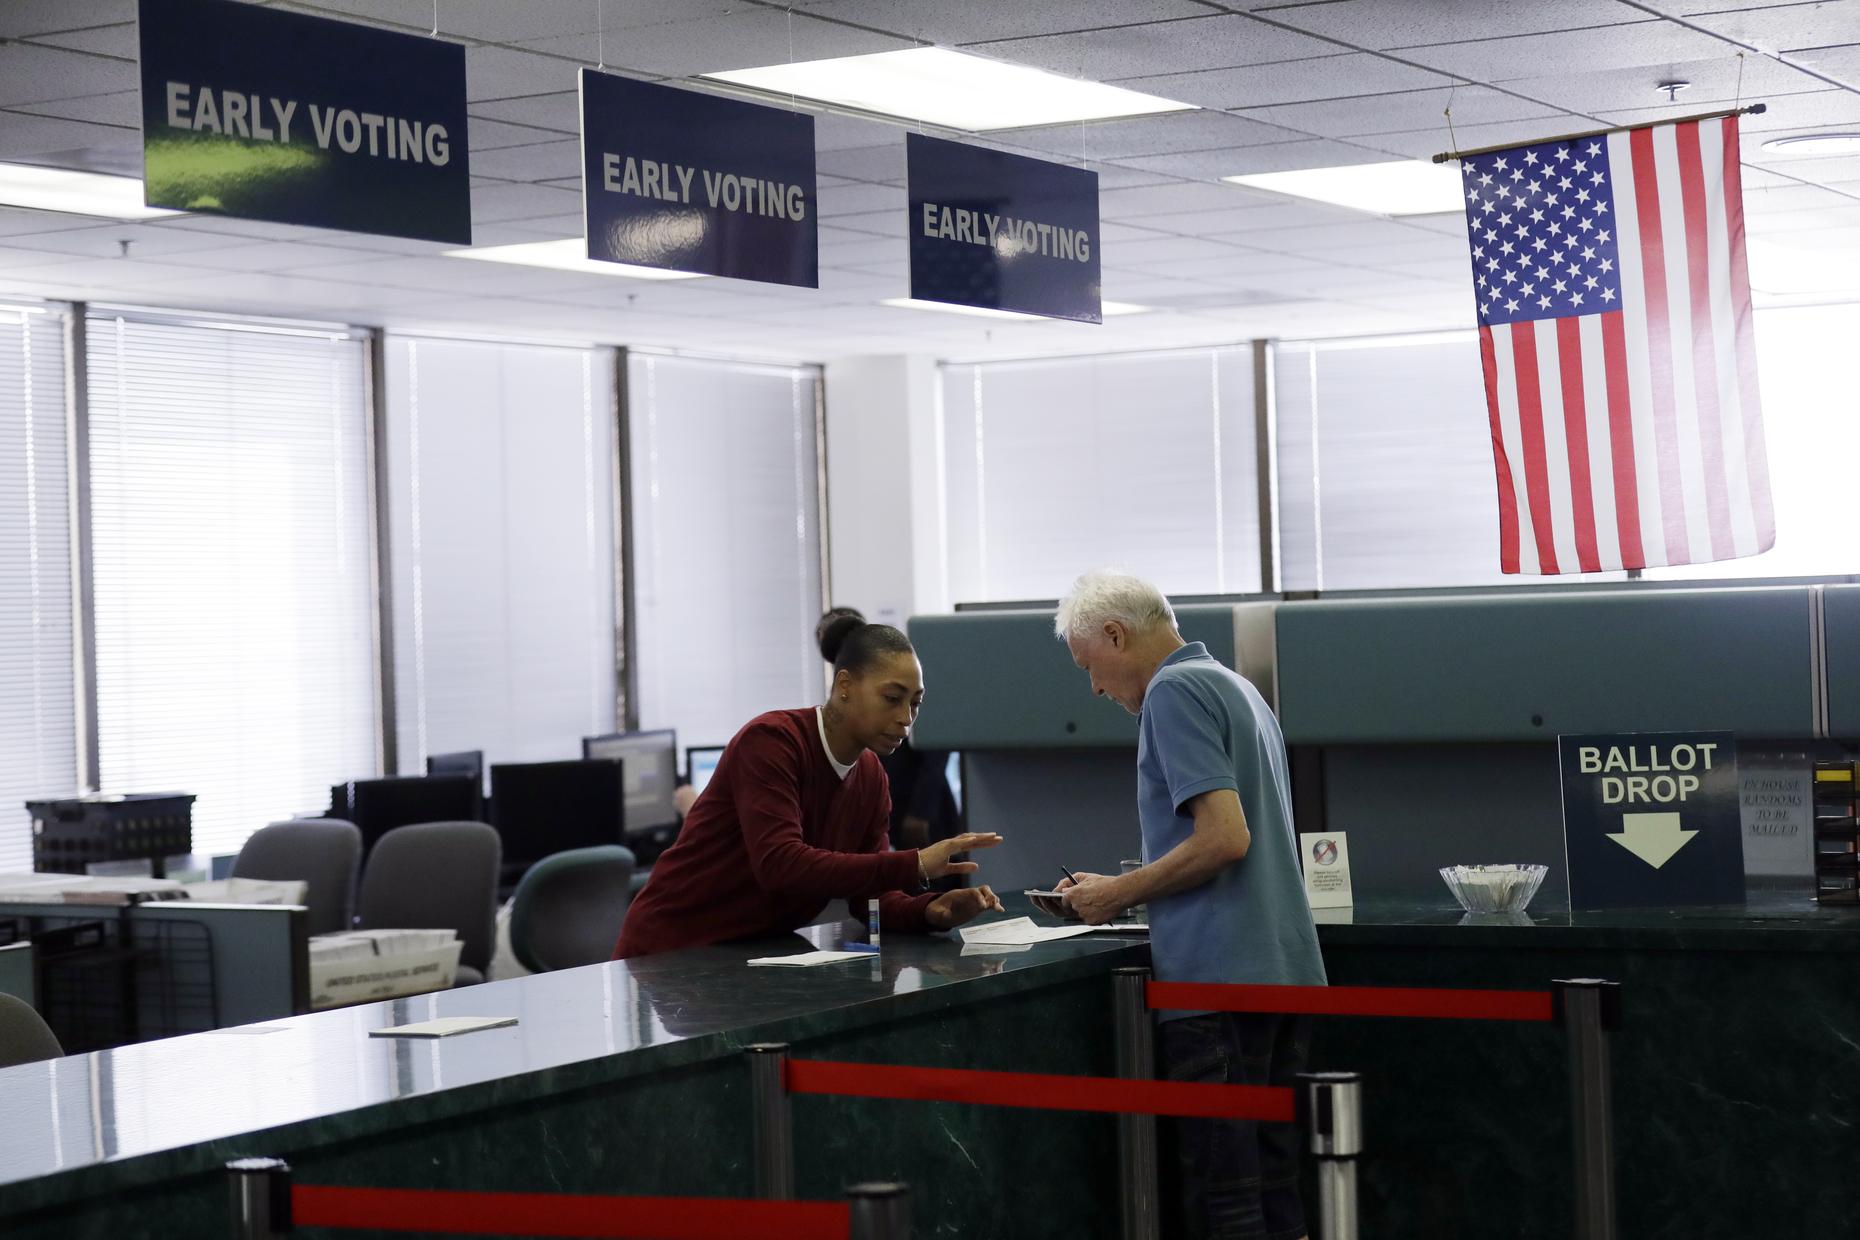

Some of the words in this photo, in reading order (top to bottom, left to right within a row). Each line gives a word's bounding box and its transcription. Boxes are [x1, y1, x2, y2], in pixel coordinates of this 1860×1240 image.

[166, 81, 297, 143] EARLY
[309, 104, 449, 167] VOTING
[603, 152, 695, 204] EARLY
[703, 169, 805, 222] VOTING
[923, 203, 1000, 248] EARLY
[1006, 217, 1090, 263] VOTING
[1579, 743, 1717, 774] BALLOT
[1601, 775, 1699, 804] DROP
